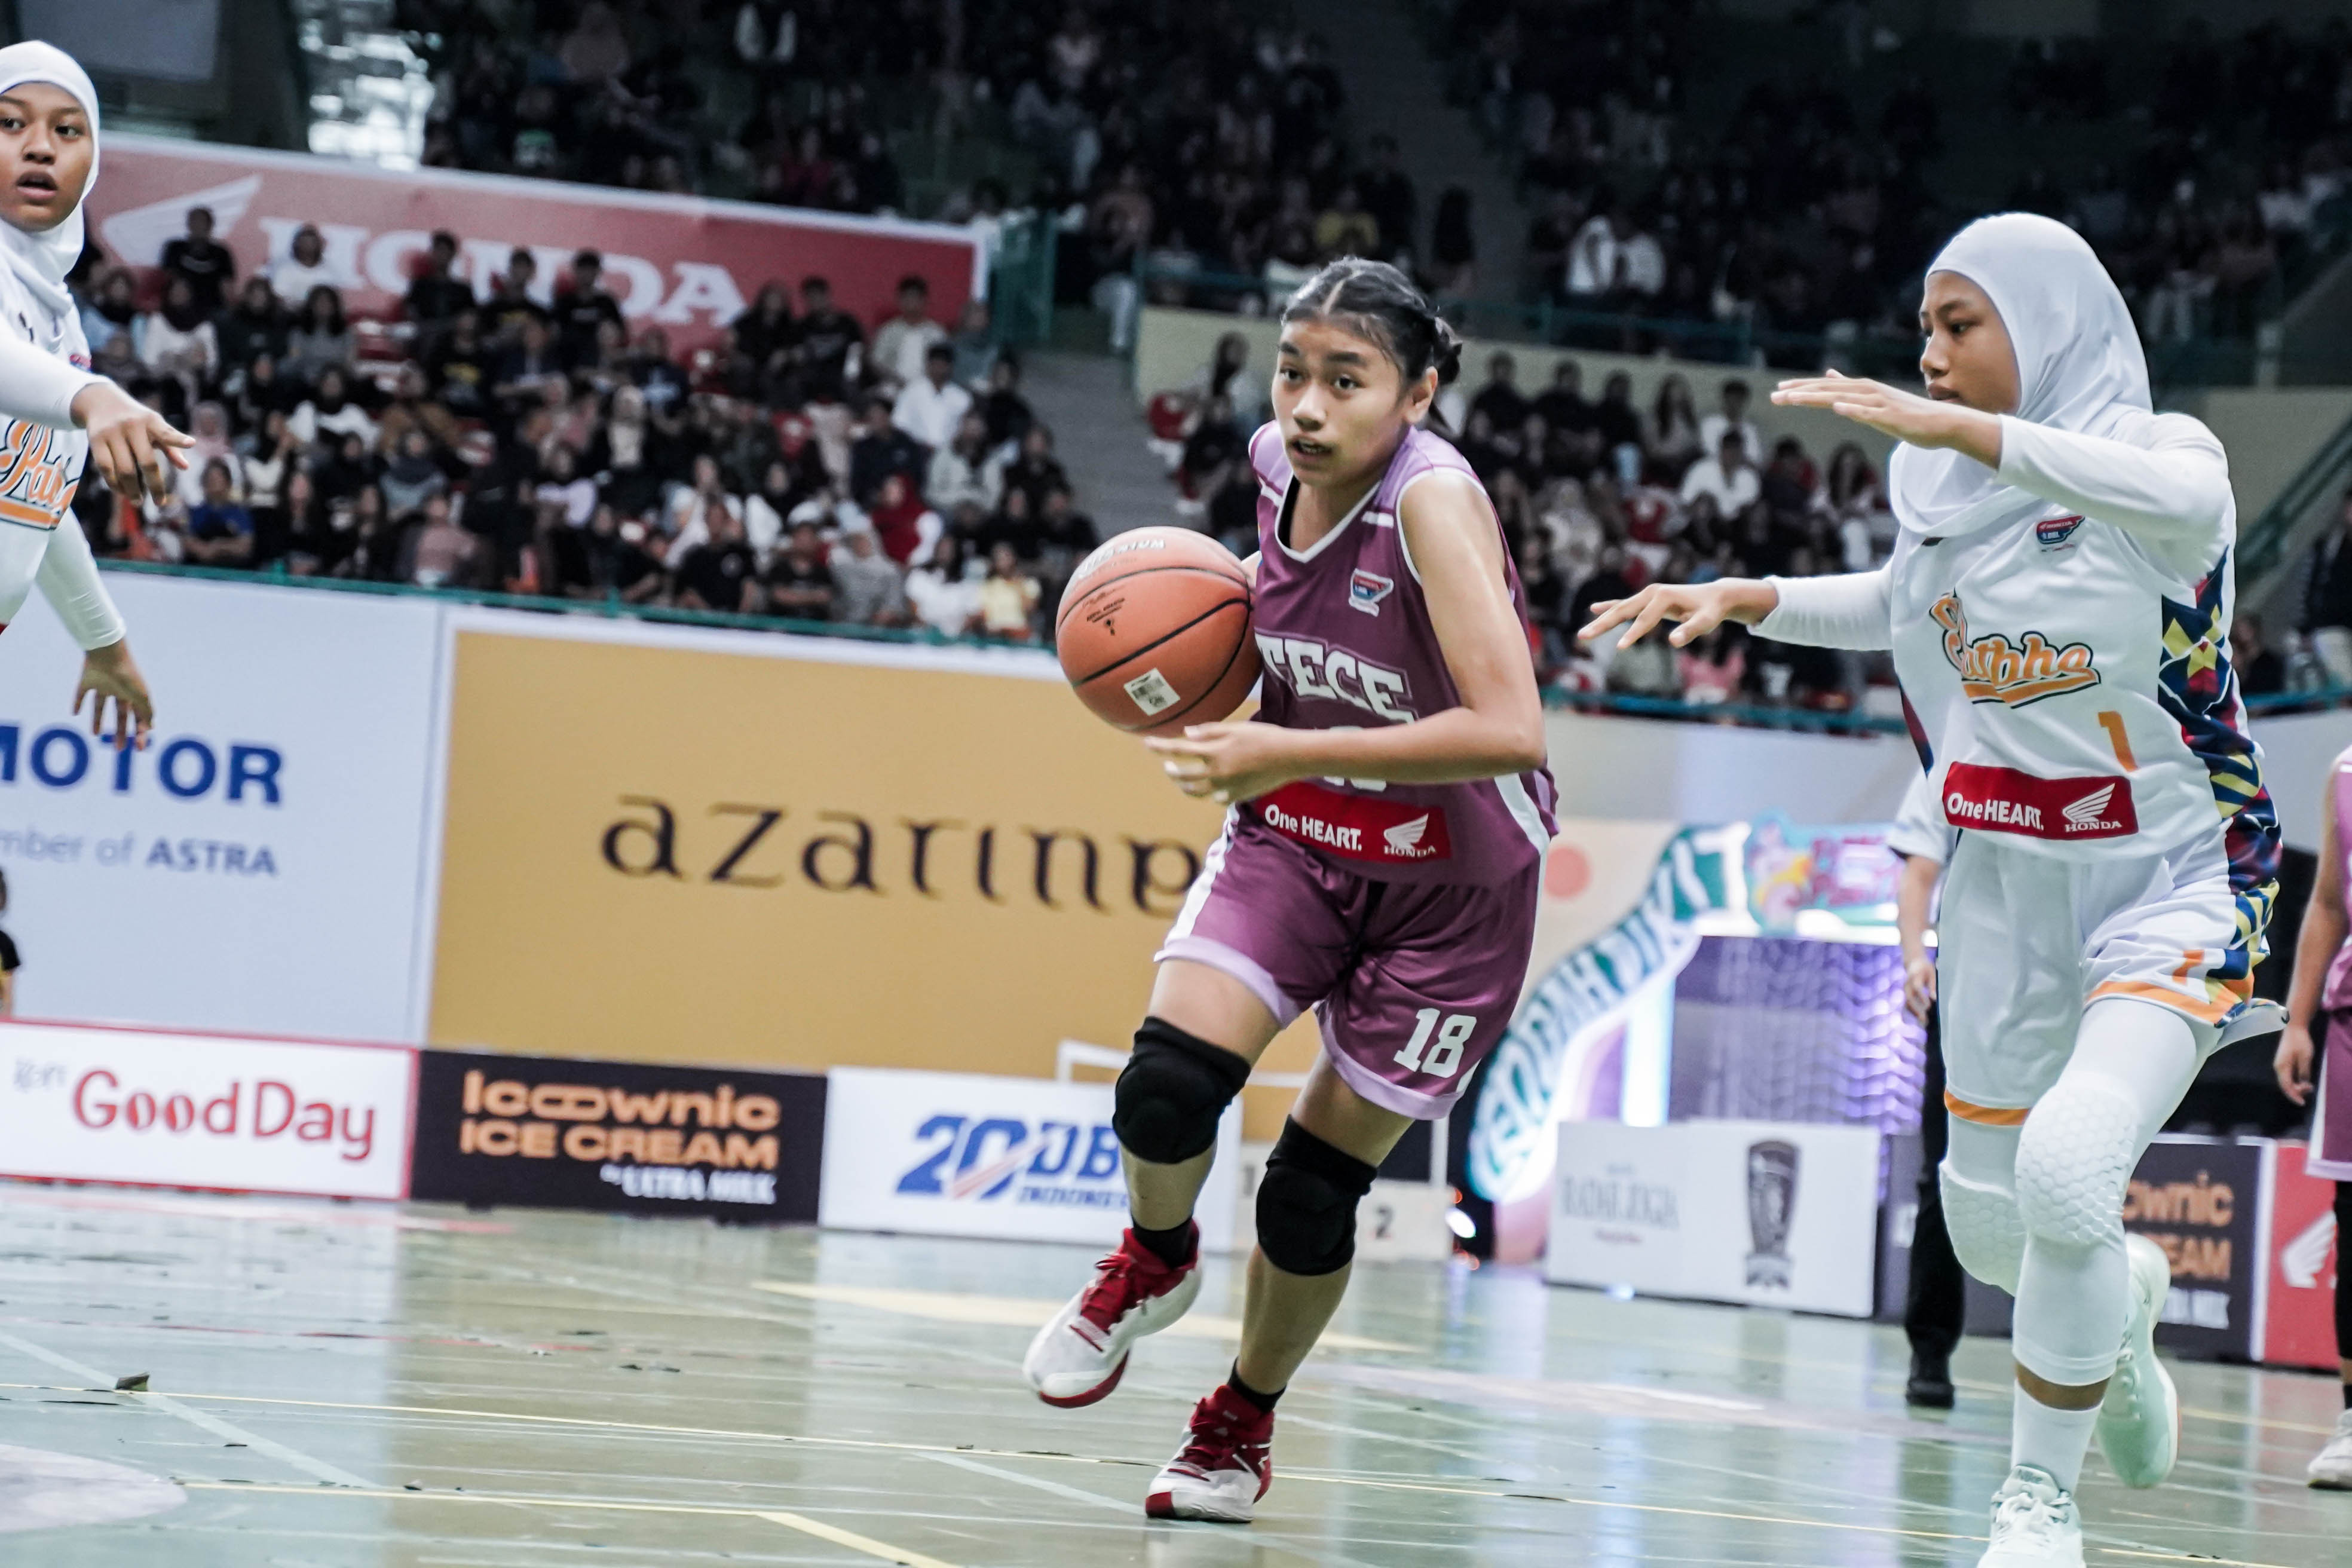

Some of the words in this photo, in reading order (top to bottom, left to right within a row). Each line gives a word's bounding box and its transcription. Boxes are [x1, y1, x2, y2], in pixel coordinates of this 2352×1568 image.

[258, 216, 750, 327] HONDA
[1264, 804, 1298, 834] One
[1301, 815, 1362, 852] HEART.
[1947, 792, 1983, 819] One
[1983, 799, 2044, 831] HEART.
[2065, 820, 2123, 832] HONDA
[96, 831, 134, 864] of
[147, 837, 277, 875] ASTRA
[1383, 844, 1437, 858] HONDA
[1393, 1007, 1477, 1078] 18
[73, 1069, 241, 1135] Good
[253, 1081, 376, 1162] Day
[460, 1118, 558, 1158] ICE
[563, 1124, 780, 1171] CREAM
[896, 1114, 1028, 1200] 20
[1375, 1205, 1394, 1239] 2
